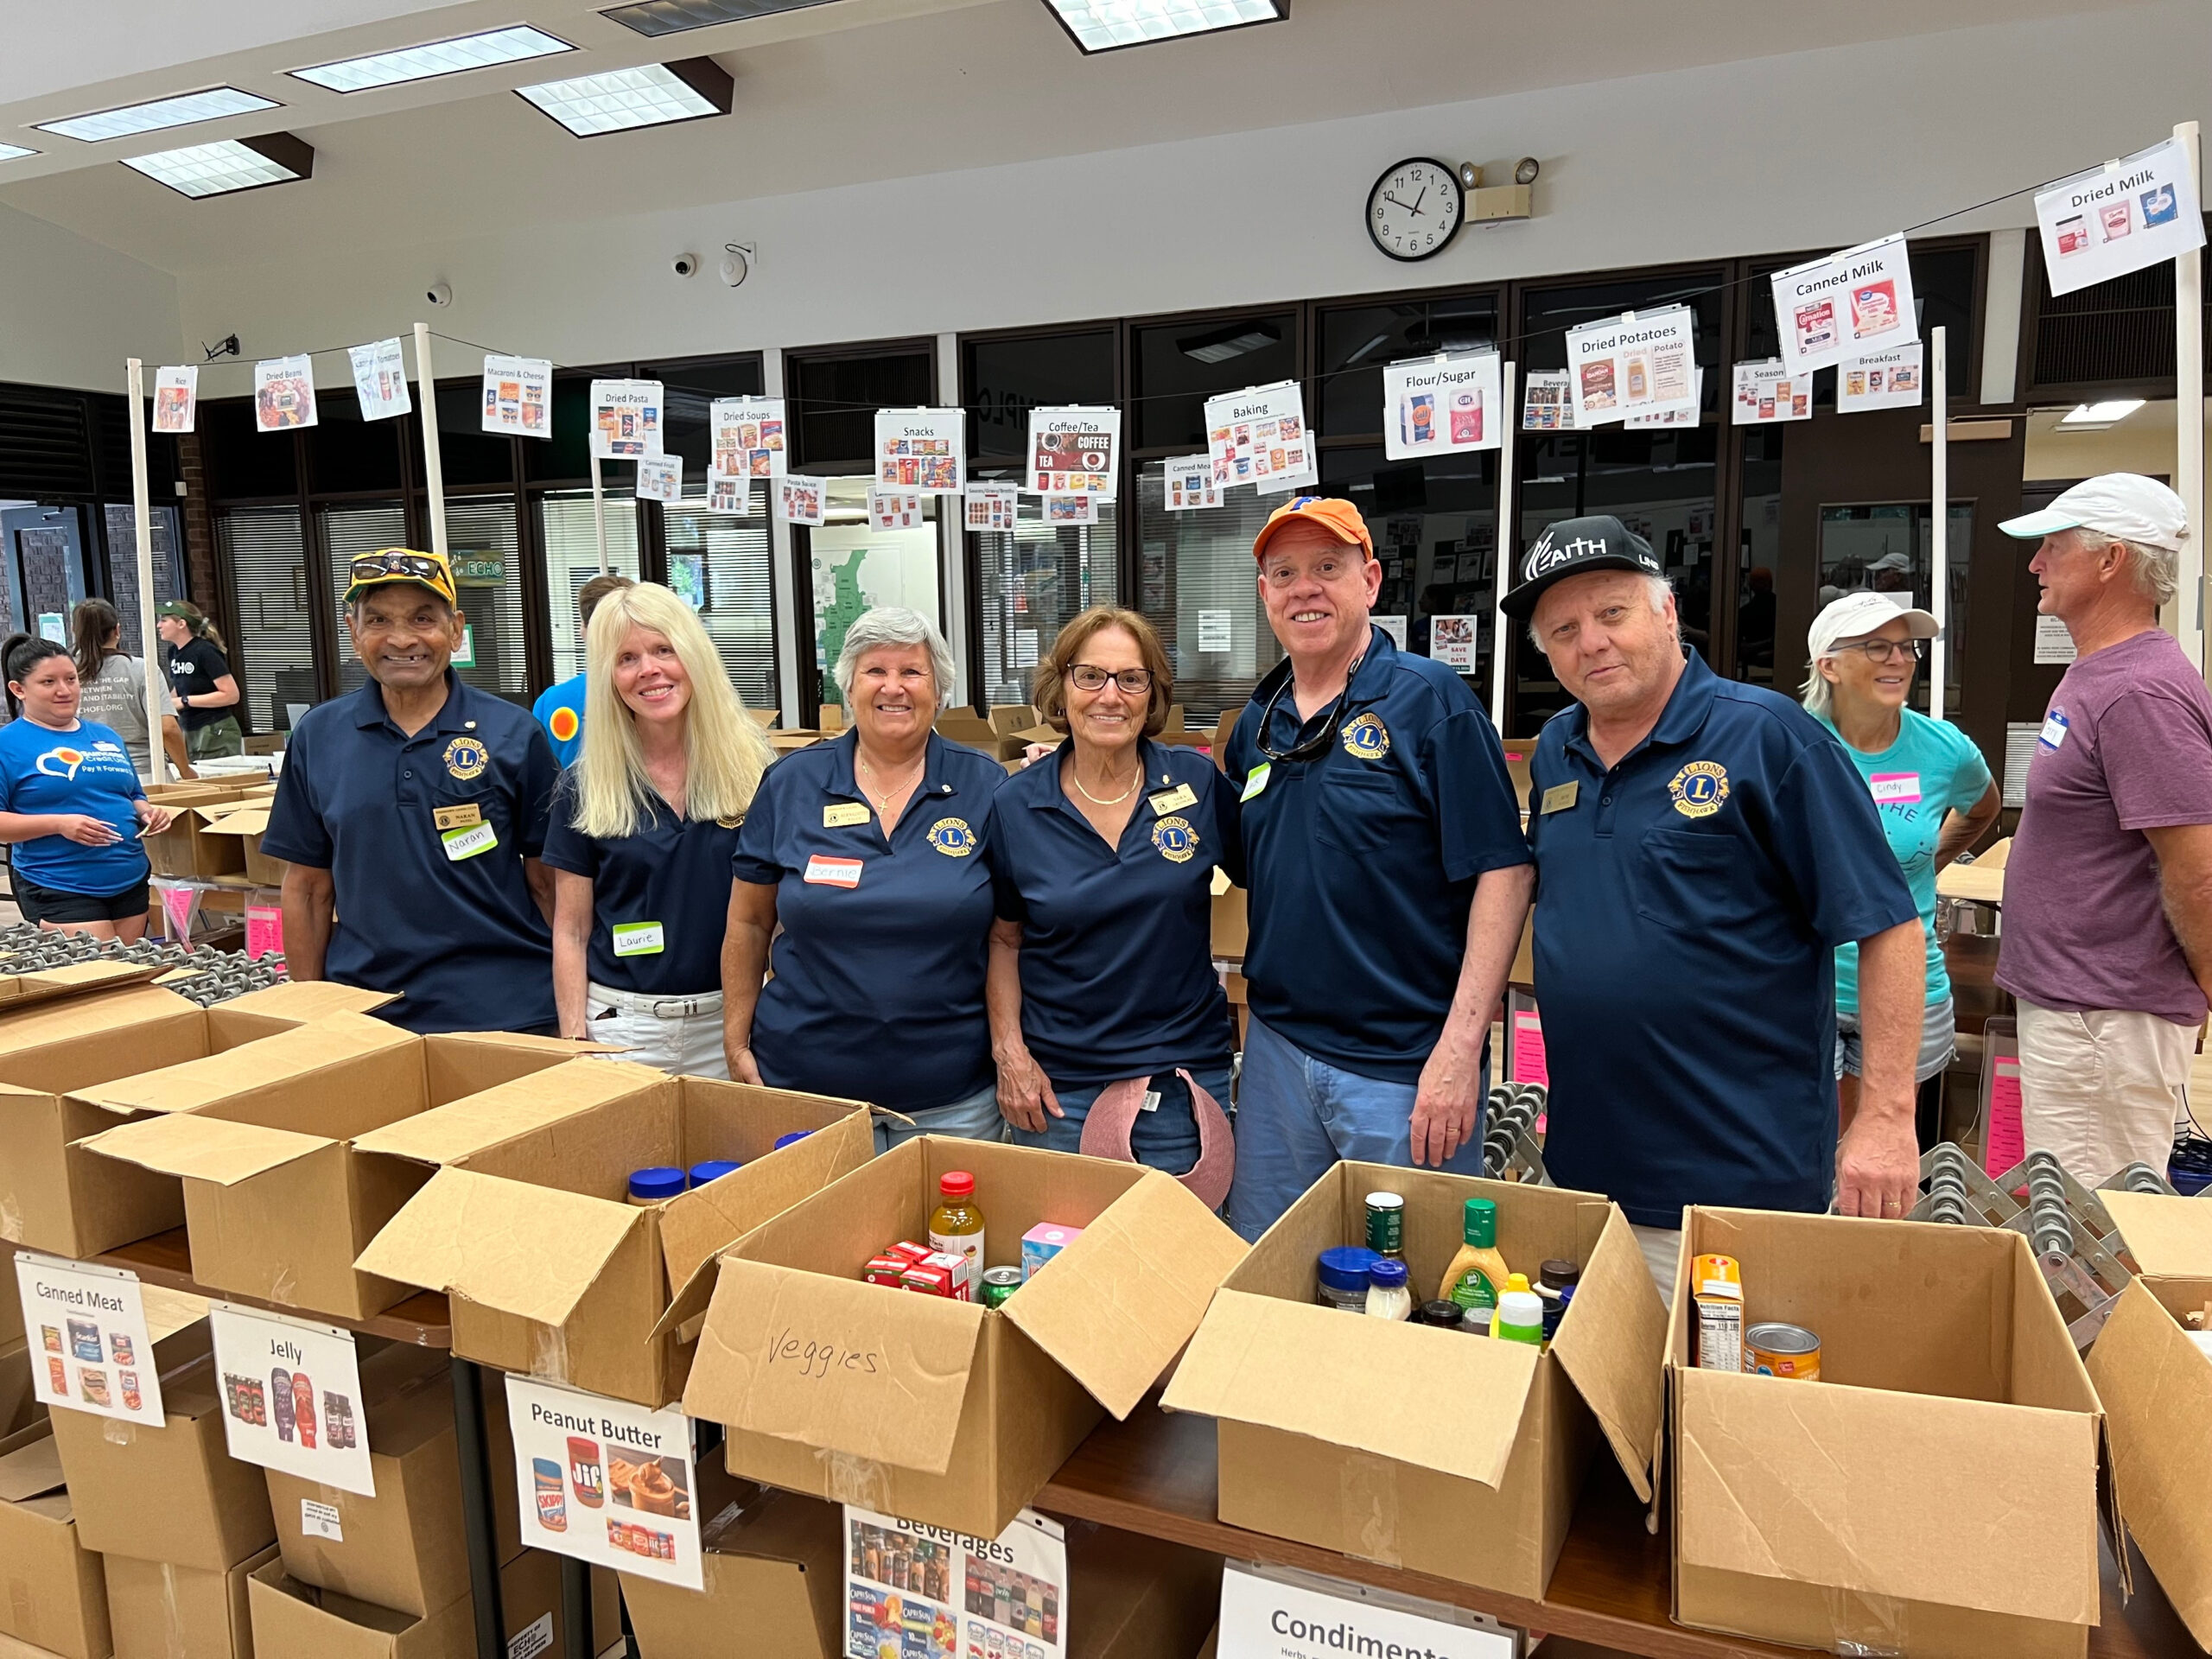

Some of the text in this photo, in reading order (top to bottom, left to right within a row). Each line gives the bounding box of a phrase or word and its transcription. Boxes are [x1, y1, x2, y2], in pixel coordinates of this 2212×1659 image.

[1410, 170, 1421, 181] 12
[1430, 175, 1434, 185] 1
[1395, 177, 1404, 188] 11
[2072, 170, 2154, 207] Dried Milk
[1440, 184, 1447, 195] 2
[1382, 191, 1394, 201] 10
[1377, 208, 1384, 219] 9
[1446, 202, 1452, 213] 3
[1382, 225, 1389, 235] 8
[1439, 220, 1446, 231] 4
[1395, 237, 1402, 247] 7
[1410, 240, 1417, 251] 6
[1427, 234, 1433, 245] 5
[1796, 260, 1884, 296] Canned Milk
[1582, 327, 1677, 353] Dried Potatoes
[1655, 342, 1683, 353] Potato
[1859, 353, 1901, 365] Breakfast
[266, 369, 302, 381] Dried Beans
[487, 368, 516, 378] Macaroni
[523, 371, 545, 381] Cheese
[1406, 369, 1476, 387] Flour/Sugar
[606, 393, 649, 404] Dried Pasta
[723, 411, 771, 422] Dried Soups
[1234, 404, 1268, 418] Baking
[904, 427, 934, 436] Snacks
[1049, 422, 1098, 433] Coffee/Tea
[1078, 436, 1109, 449] COFFEE
[1039, 456, 1053, 467] TEA
[467, 561, 503, 577] ECHO
[1360, 728, 1376, 747] L
[454, 739, 480, 749] LIONS
[461, 750, 474, 766] L
[1687, 763, 1725, 777] LIONS
[1692, 778, 1709, 799] L
[1877, 782, 1902, 794] Cindy
[936, 818, 966, 829] LIONS
[1157, 818, 1187, 829] LIONS
[448, 831, 485, 853] Naran
[946, 831, 959, 845] L
[1168, 831, 1182, 847] L
[810, 865, 857, 880] Bernie
[620, 932, 654, 947] Laurie
[36, 1281, 124, 1313] Canned Meat
[271, 1338, 302, 1366] Jelly
[769, 1328, 877, 1377] Veggies
[531, 1403, 662, 1449] Peanut Butter
[896, 1517, 1014, 1564] Beverages
